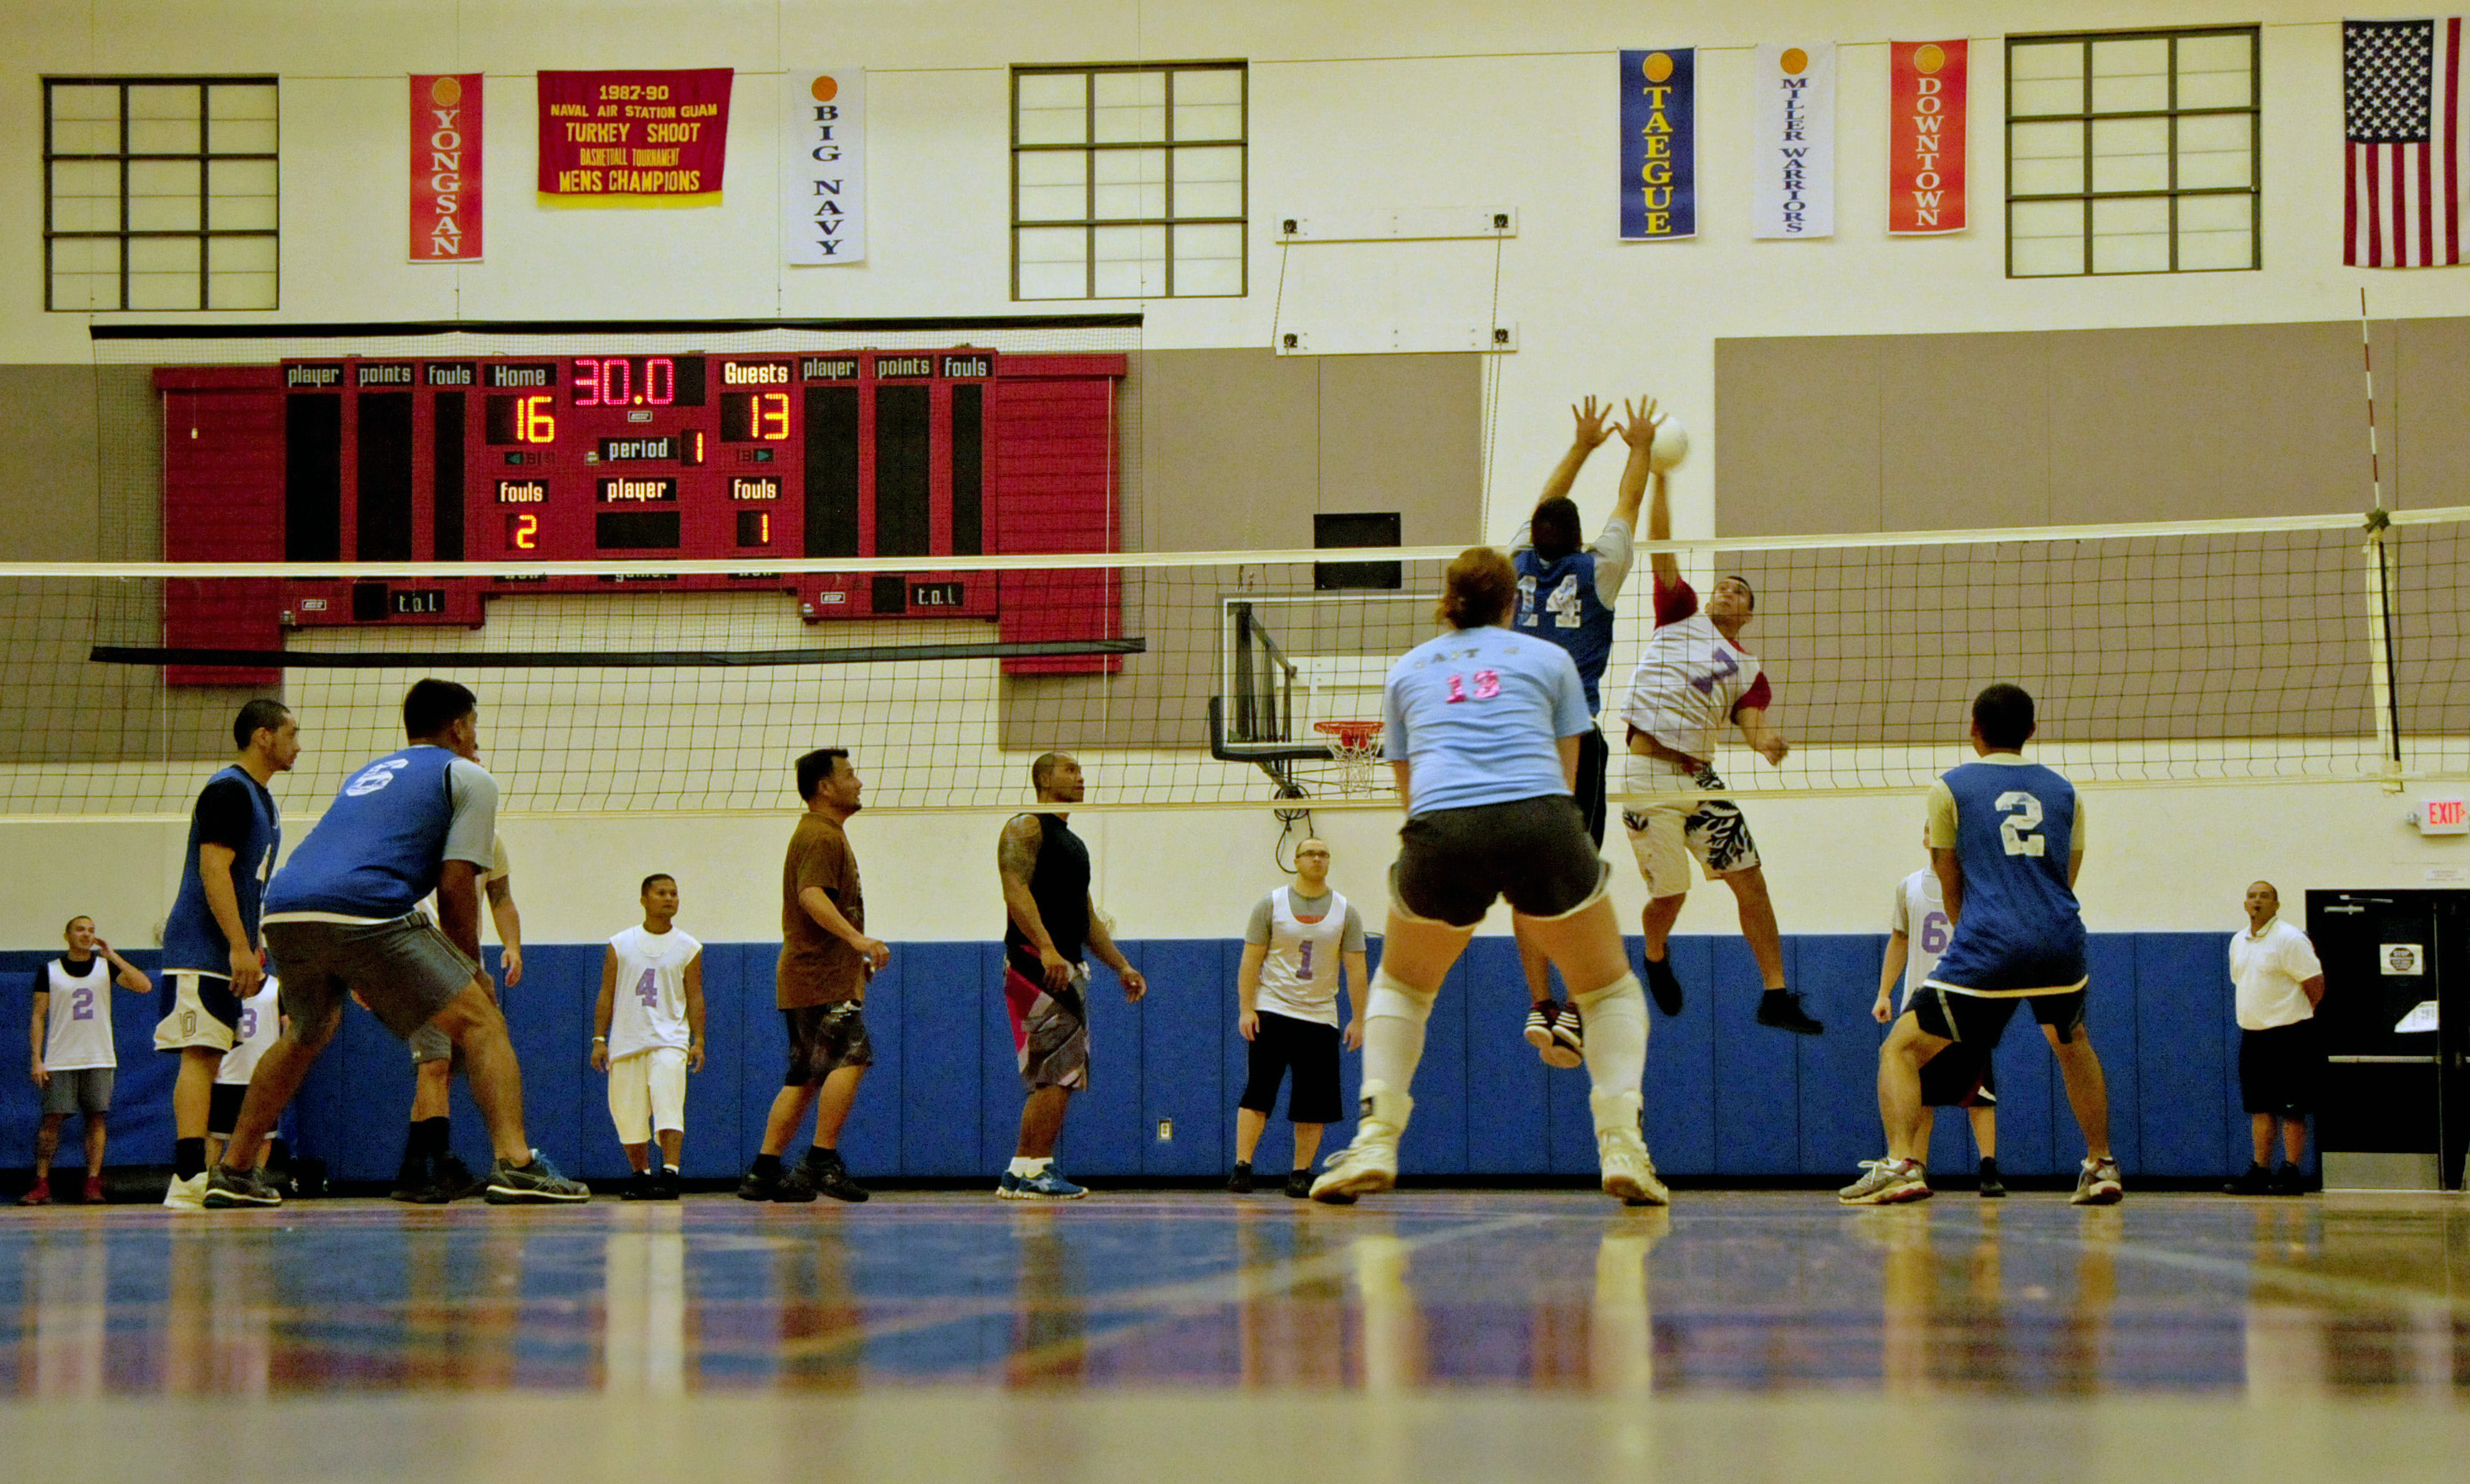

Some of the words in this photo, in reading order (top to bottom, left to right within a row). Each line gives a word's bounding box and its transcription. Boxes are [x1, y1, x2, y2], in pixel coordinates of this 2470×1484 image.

[599, 85, 669, 100] 1987-90
[550, 104, 589, 117] NAVAL
[597, 105, 618, 117] AIR
[624, 104, 676, 119] STATION
[681, 104, 717, 118] GUAM
[1781, 78, 1808, 141] MILLER
[566, 122, 630, 143] TURKEY
[646, 123, 701, 143] SHOOT
[812, 106, 841, 162] BIG
[580, 147, 628, 166] BASKETBALL
[632, 147, 680, 167] TOURNAMENT
[1642, 86, 1673, 234] TAEGUE
[1913, 78, 1944, 226] DOWNTOWN
[431, 110, 462, 255] YONGSAN
[560, 170, 603, 192] MENS
[608, 170, 700, 192] CHAMPIONS
[1779, 147, 1810, 233] WARRIORS
[814, 179, 844, 255] NAVY
[288, 365, 340, 388] player
[359, 365, 411, 387] points
[429, 366, 471, 385] fouls
[495, 365, 546, 387] Home
[575, 359, 673, 405] 30.0
[725, 362, 789, 384] Guests
[803, 358, 855, 381] player
[878, 357, 930, 380] points
[945, 357, 987, 377] fouls
[516, 395, 556, 443] 16
[751, 393, 790, 440] 13
[608, 437, 668, 462] period
[696, 432, 704, 463] 1
[500, 482, 543, 502] fouls
[607, 477, 667, 503] player
[733, 479, 777, 499] fouls
[516, 513, 538, 549] 2
[761, 513, 769, 544] 1
[1517, 574, 1582, 628] 14
[1691, 646, 1739, 694] 7
[1445, 669, 1500, 704] 13
[346, 758, 409, 796] 6
[1994, 790, 2045, 857] 2
[2429, 801, 2461, 824] EXIT
[1921, 911, 1948, 953] 6
[1295, 940, 1313, 979] 1
[635, 968, 658, 1007] 4
[72, 988, 94, 1020] 2
